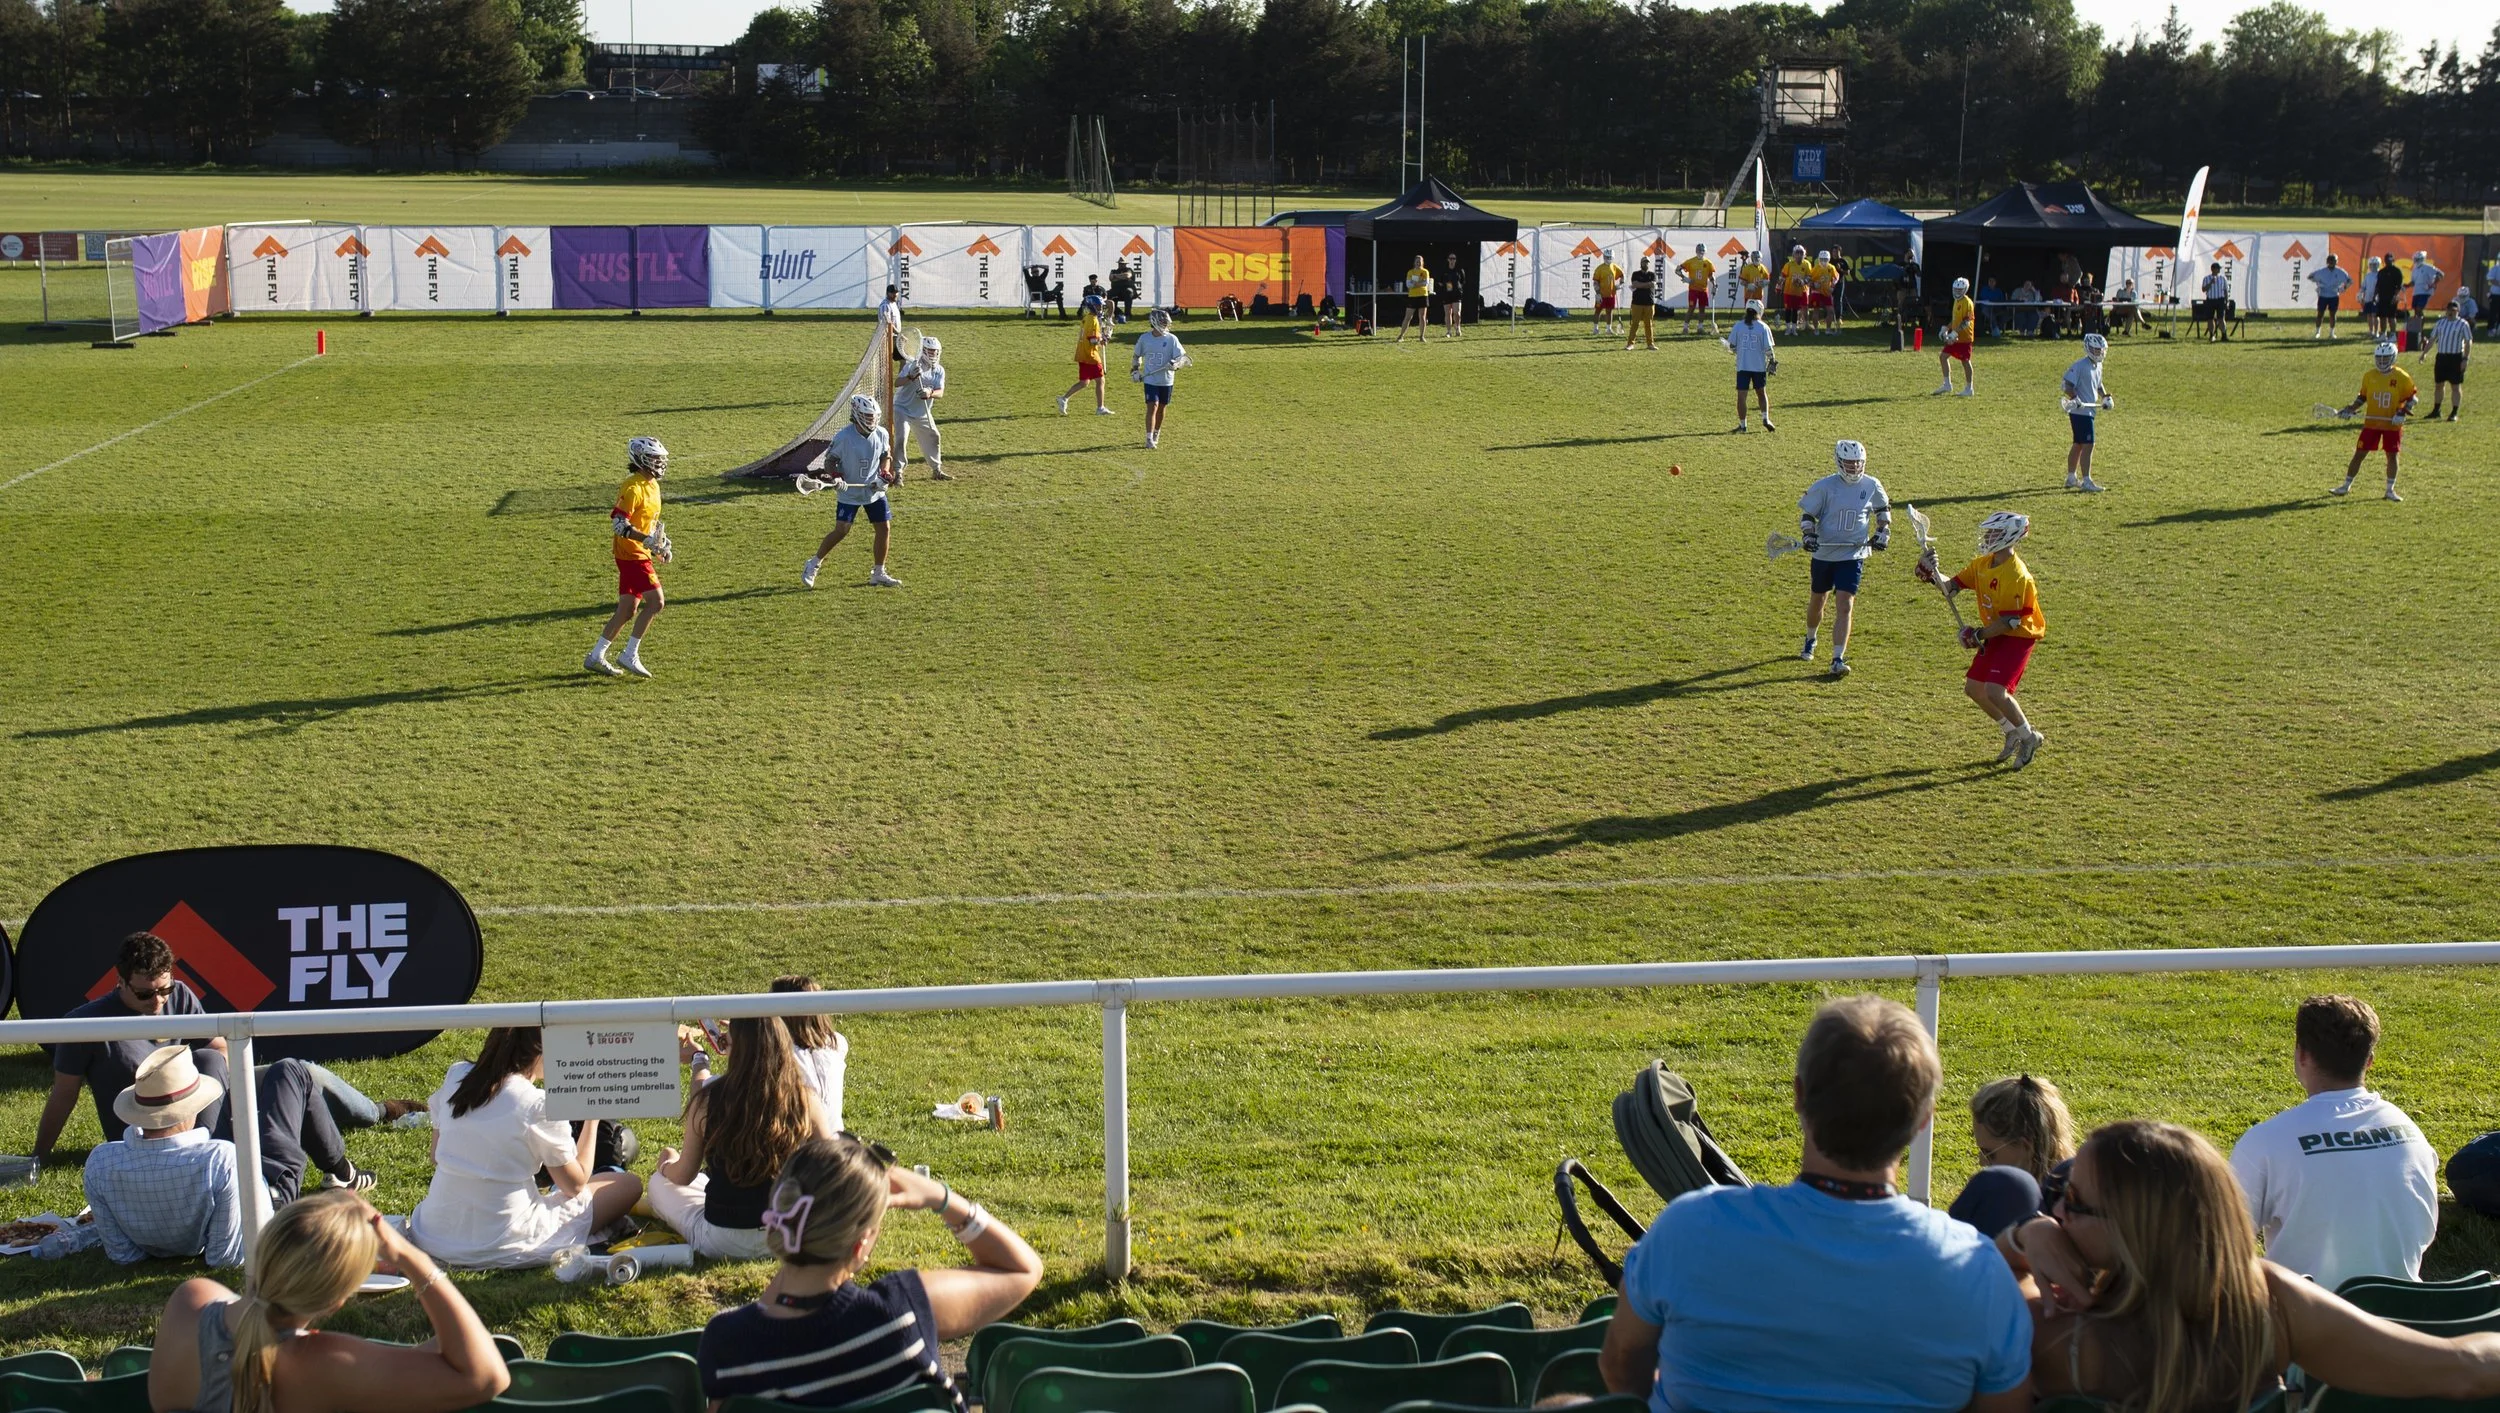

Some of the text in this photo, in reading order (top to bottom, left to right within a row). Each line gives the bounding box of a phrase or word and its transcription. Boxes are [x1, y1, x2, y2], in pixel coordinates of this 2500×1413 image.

[1798, 149, 1821, 161] TIDY
[267, 257, 278, 303] THE FLY
[349, 256, 359, 302] THE FLY
[428, 257, 439, 302] THE FLY
[509, 256, 520, 301] THE FLY
[577, 251, 684, 283] HUSTLE
[900, 256, 910, 300] THE FLY
[979, 255, 989, 300] THE FLY
[1055, 256, 1064, 278] THE
[1208, 252, 1292, 282] RISE
[1581, 257, 1590, 300] THE FLY
[1728, 257, 1737, 301] THE FLY
[2155, 259, 2164, 280] THE
[2291, 260, 2300, 302] THE FLY
[1655, 282, 1663, 300] FLY
[1149, 352, 1164, 366] 23
[1838, 509, 1857, 531] 10
[277, 902, 408, 952] THE
[288, 952, 407, 1002] FLY
[601, 1036, 634, 1044] RUGBY
[556, 1059, 567, 1068] To
[569, 1058, 594, 1067] avoid
[596, 1057, 648, 1067] obstructing
[563, 1070, 659, 1080] view of others please
[548, 1082, 675, 1094] refrain from using umbrellas
[587, 1096, 640, 1105] in the stand
[2298, 1124, 2416, 1151] PICANTE
